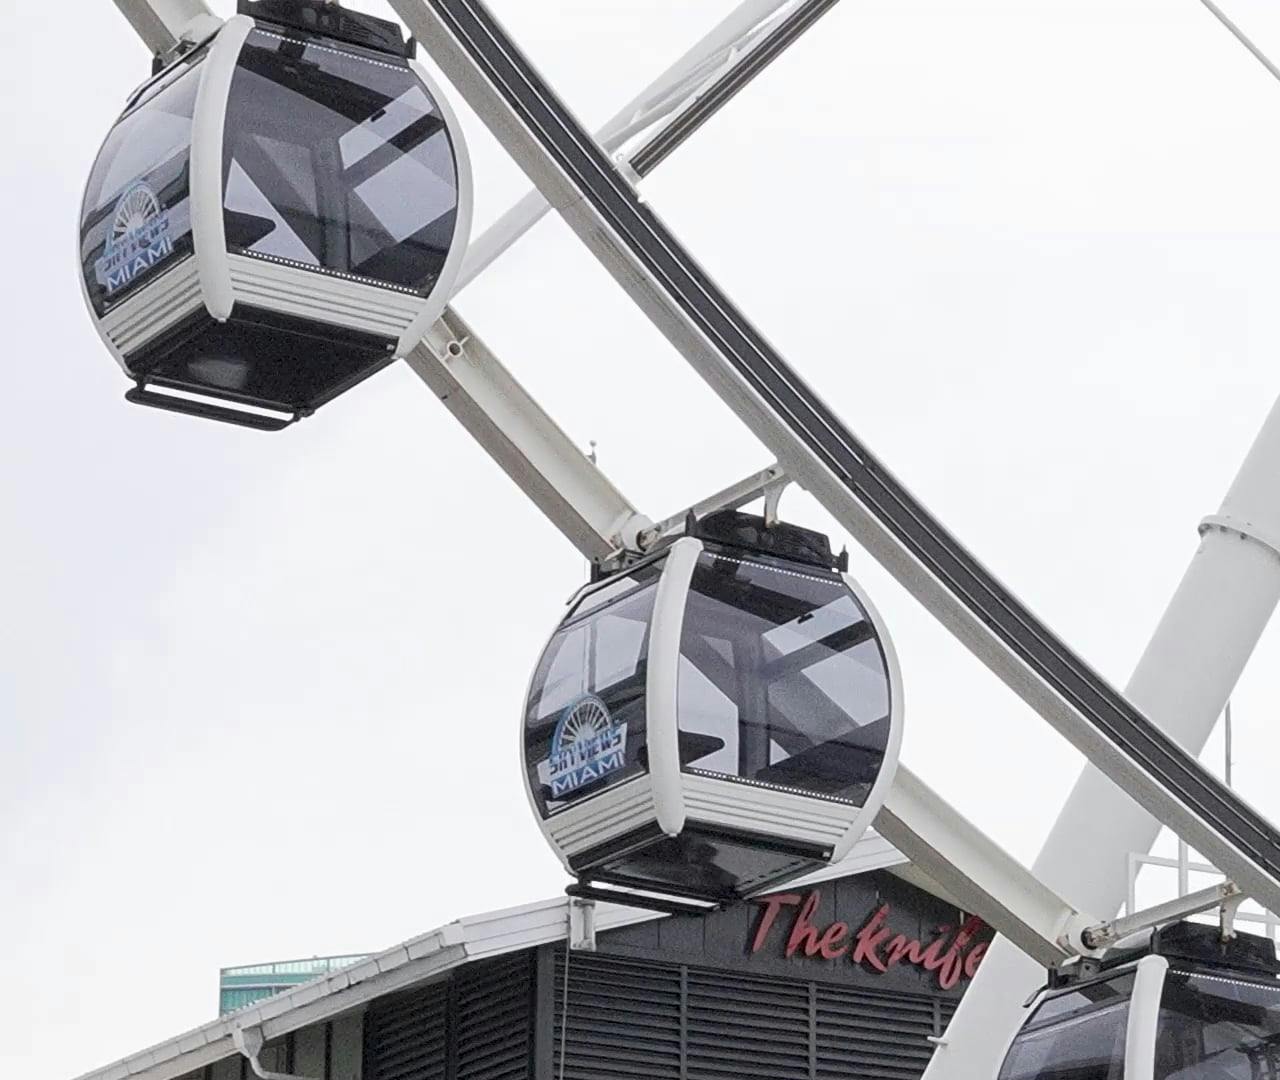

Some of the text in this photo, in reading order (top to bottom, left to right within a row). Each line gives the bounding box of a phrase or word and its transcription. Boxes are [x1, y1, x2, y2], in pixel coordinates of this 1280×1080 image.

[106, 236, 173, 293] MIAMI
[551, 750, 626, 796] MIAMI
[750, 888, 849, 960] The
